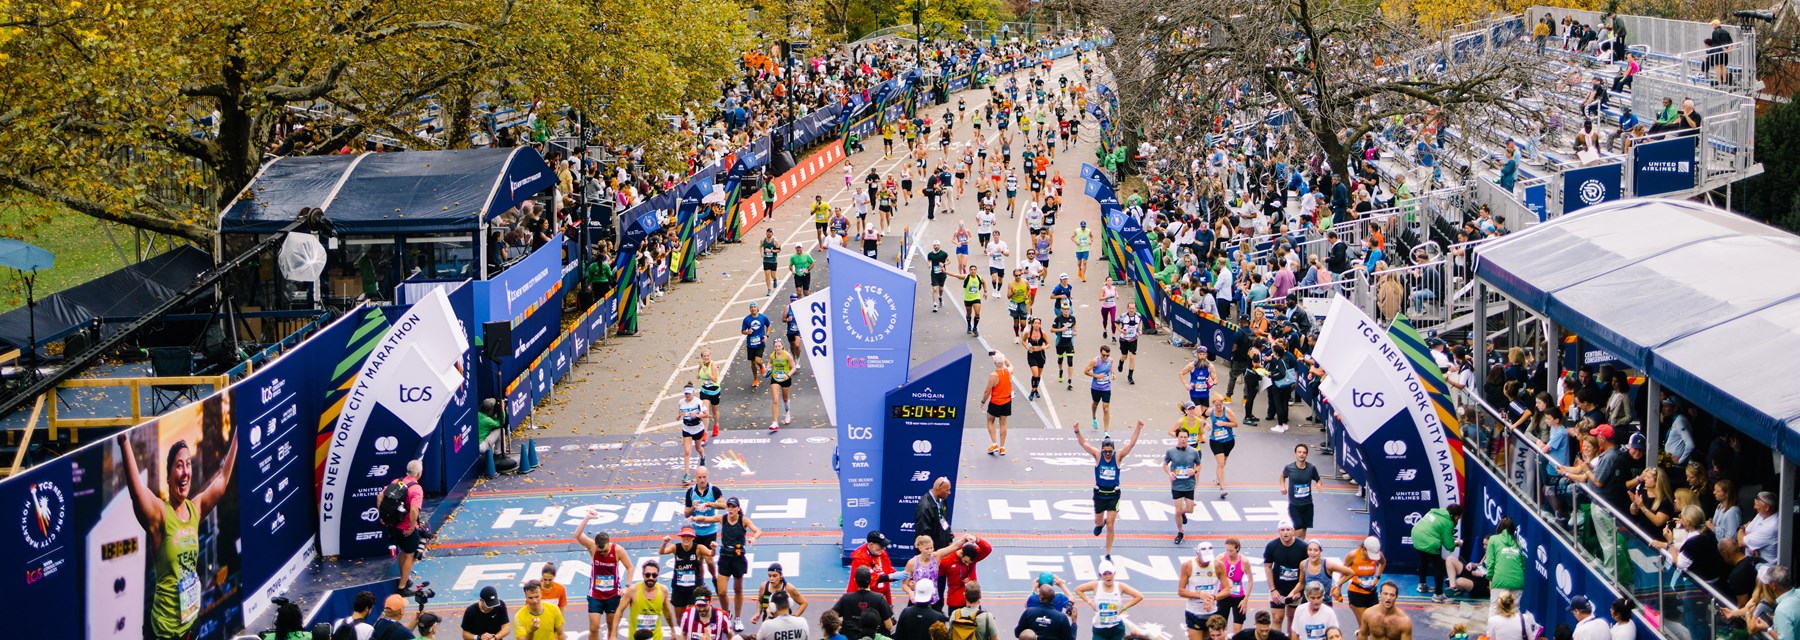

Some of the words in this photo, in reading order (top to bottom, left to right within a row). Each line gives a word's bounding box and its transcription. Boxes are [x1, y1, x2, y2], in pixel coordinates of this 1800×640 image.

[864, 285, 883, 295] TCS
[883, 293, 897, 311] NEW
[842, 295, 863, 340] MARATHON
[884, 313, 898, 335] YORK
[811, 301, 826, 357] 2022
[864, 333, 884, 342] CITY
[367, 313, 421, 380] MARATHON
[846, 354, 866, 368] tcs
[1357, 320, 1380, 344] TCS
[1379, 342, 1407, 374] NEW
[1402, 372, 1431, 412] YORK
[1424, 411, 1444, 444] CITY
[350, 380, 369, 412] CITY
[400, 384, 432, 403] tcs
[1352, 388, 1385, 408] tcs
[335, 412, 356, 448] YORK
[848, 424, 873, 440] tcs
[327, 454, 342, 486] NEW
[39, 482, 54, 491] TCS
[54, 486, 64, 502] NEW
[324, 492, 334, 522] TCS
[22, 500, 39, 548] MARATHON
[55, 505, 66, 532] YORK
[40, 534, 56, 548] CITY
[356, 530, 383, 540] ESPN
[26, 568, 43, 584] tcs
[267, 578, 282, 598] move
[774, 629, 803, 640] CREW
